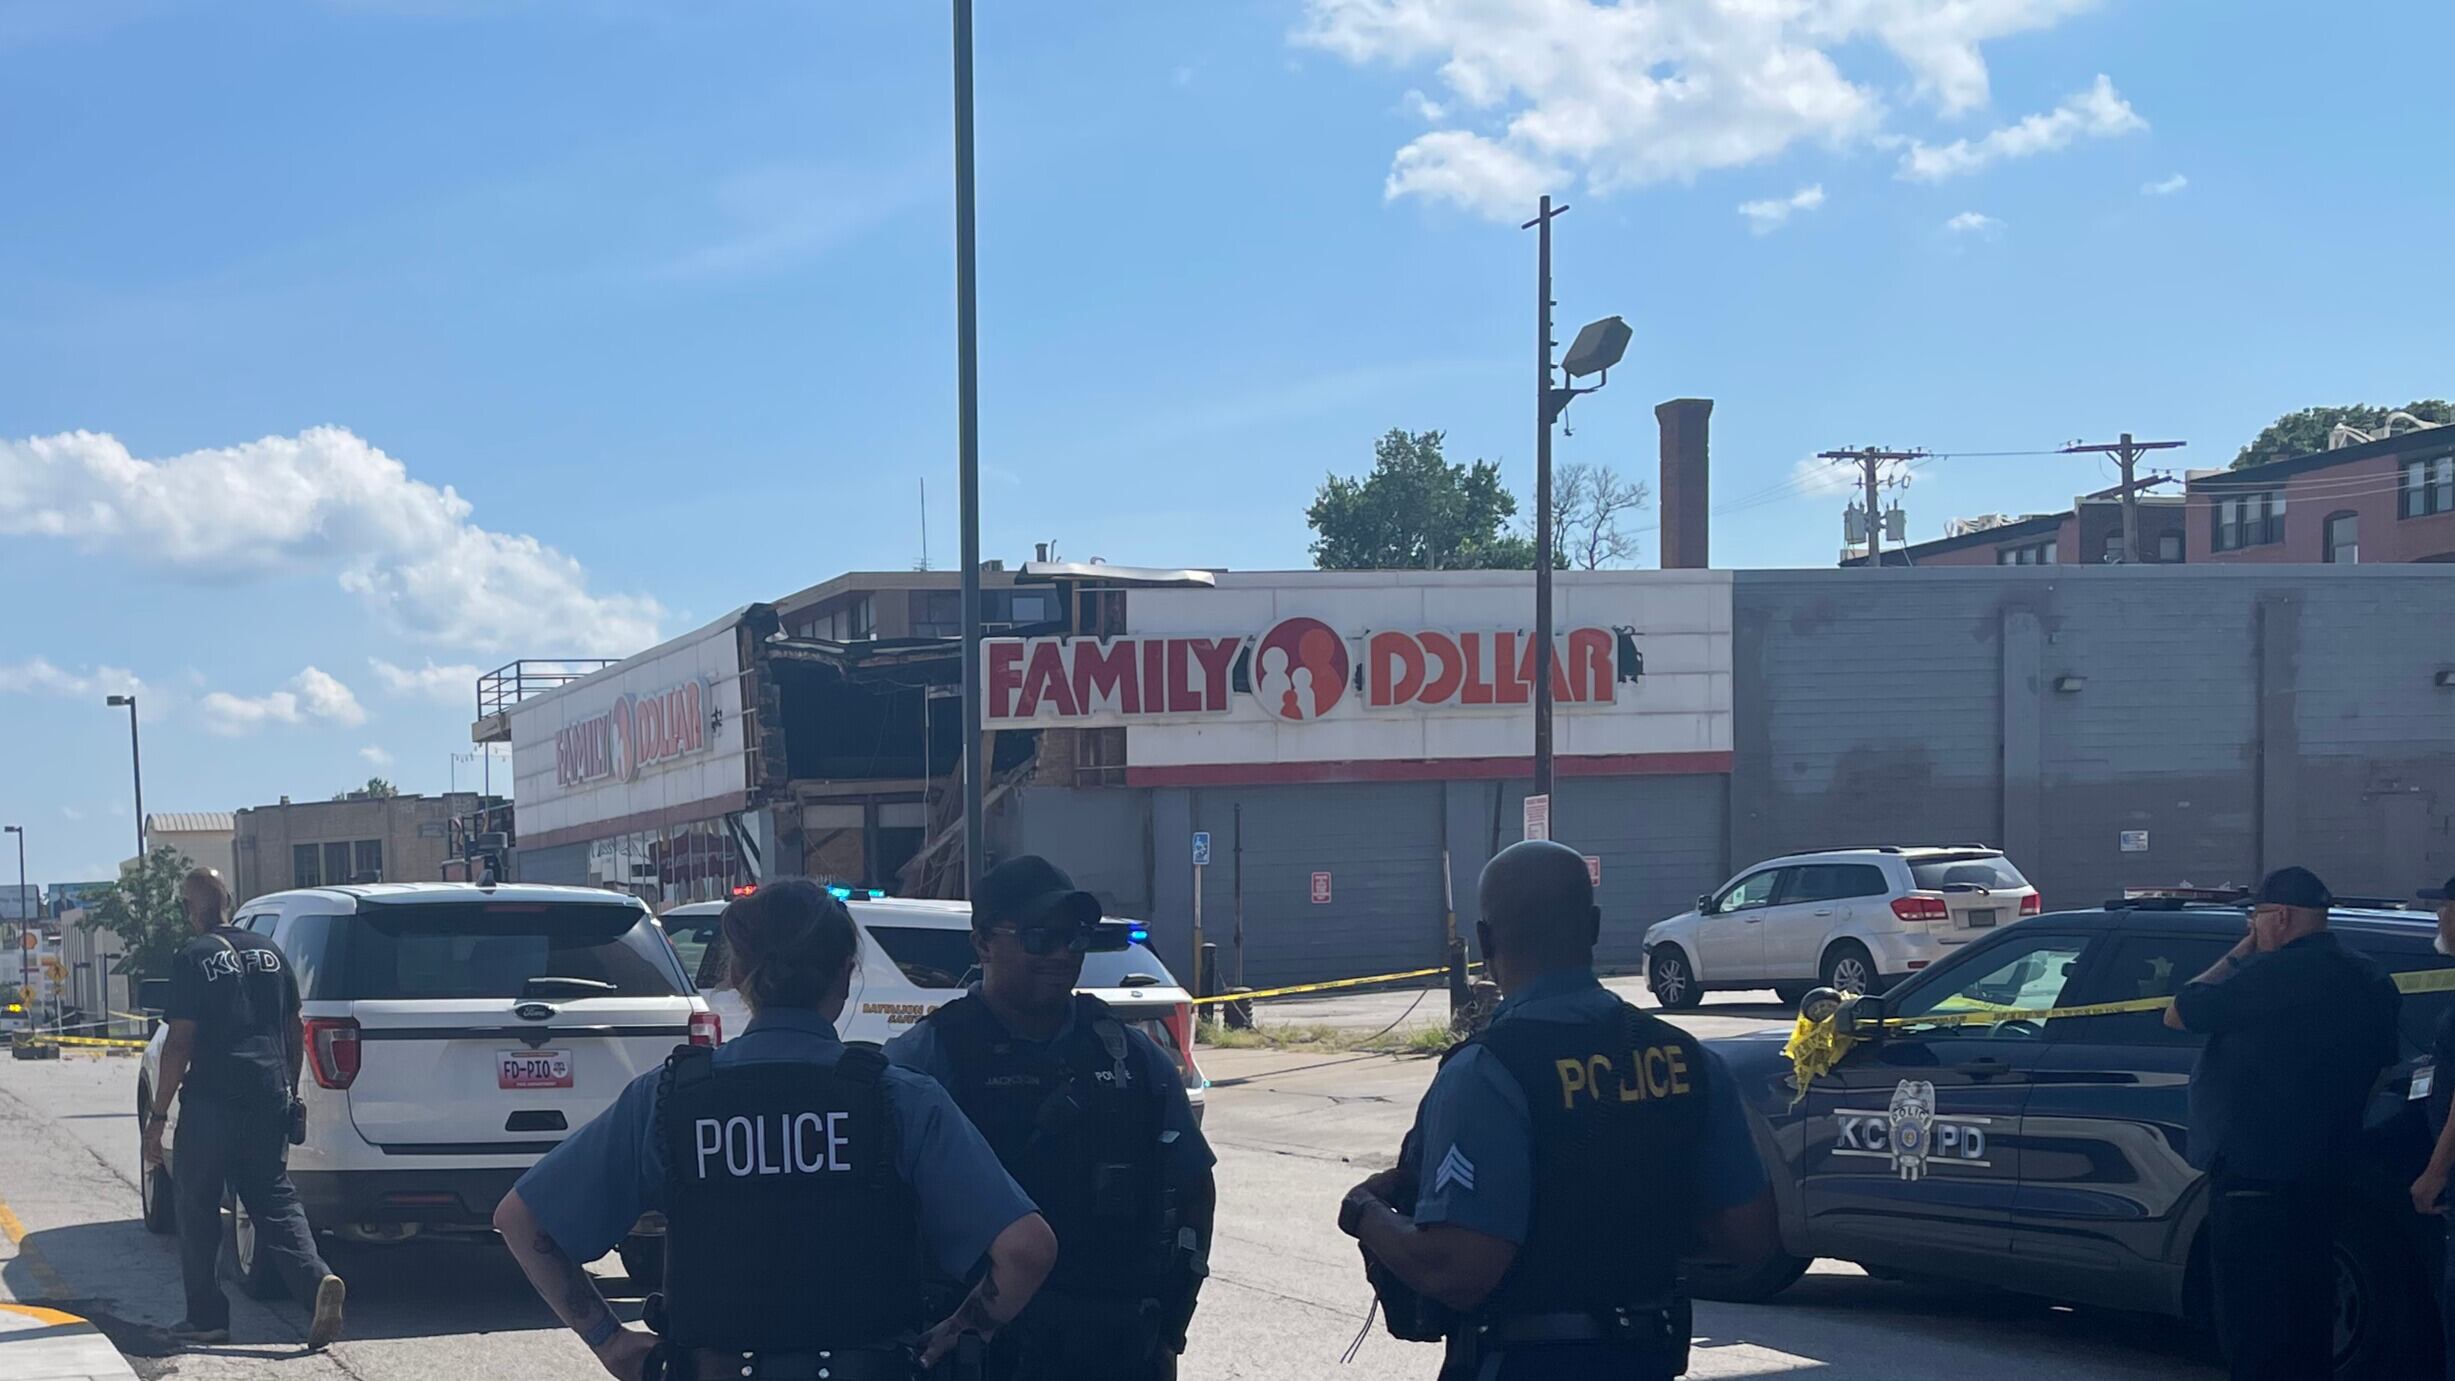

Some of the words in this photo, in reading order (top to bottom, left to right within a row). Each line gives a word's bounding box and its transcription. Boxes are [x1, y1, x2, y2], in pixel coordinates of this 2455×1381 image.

[988, 637, 1241, 718] FAMILY
[1370, 627, 1614, 706] DOLLAR
[555, 713, 609, 786] FAMILY
[636, 681, 702, 763] DOLLAR
[202, 949, 281, 982] KCFD
[503, 1060, 550, 1078] FD-PIO
[1094, 1069, 1133, 1082] POLE
[1891, 1106, 1931, 1126] POLICE
[696, 1112, 851, 1178] POLICE
